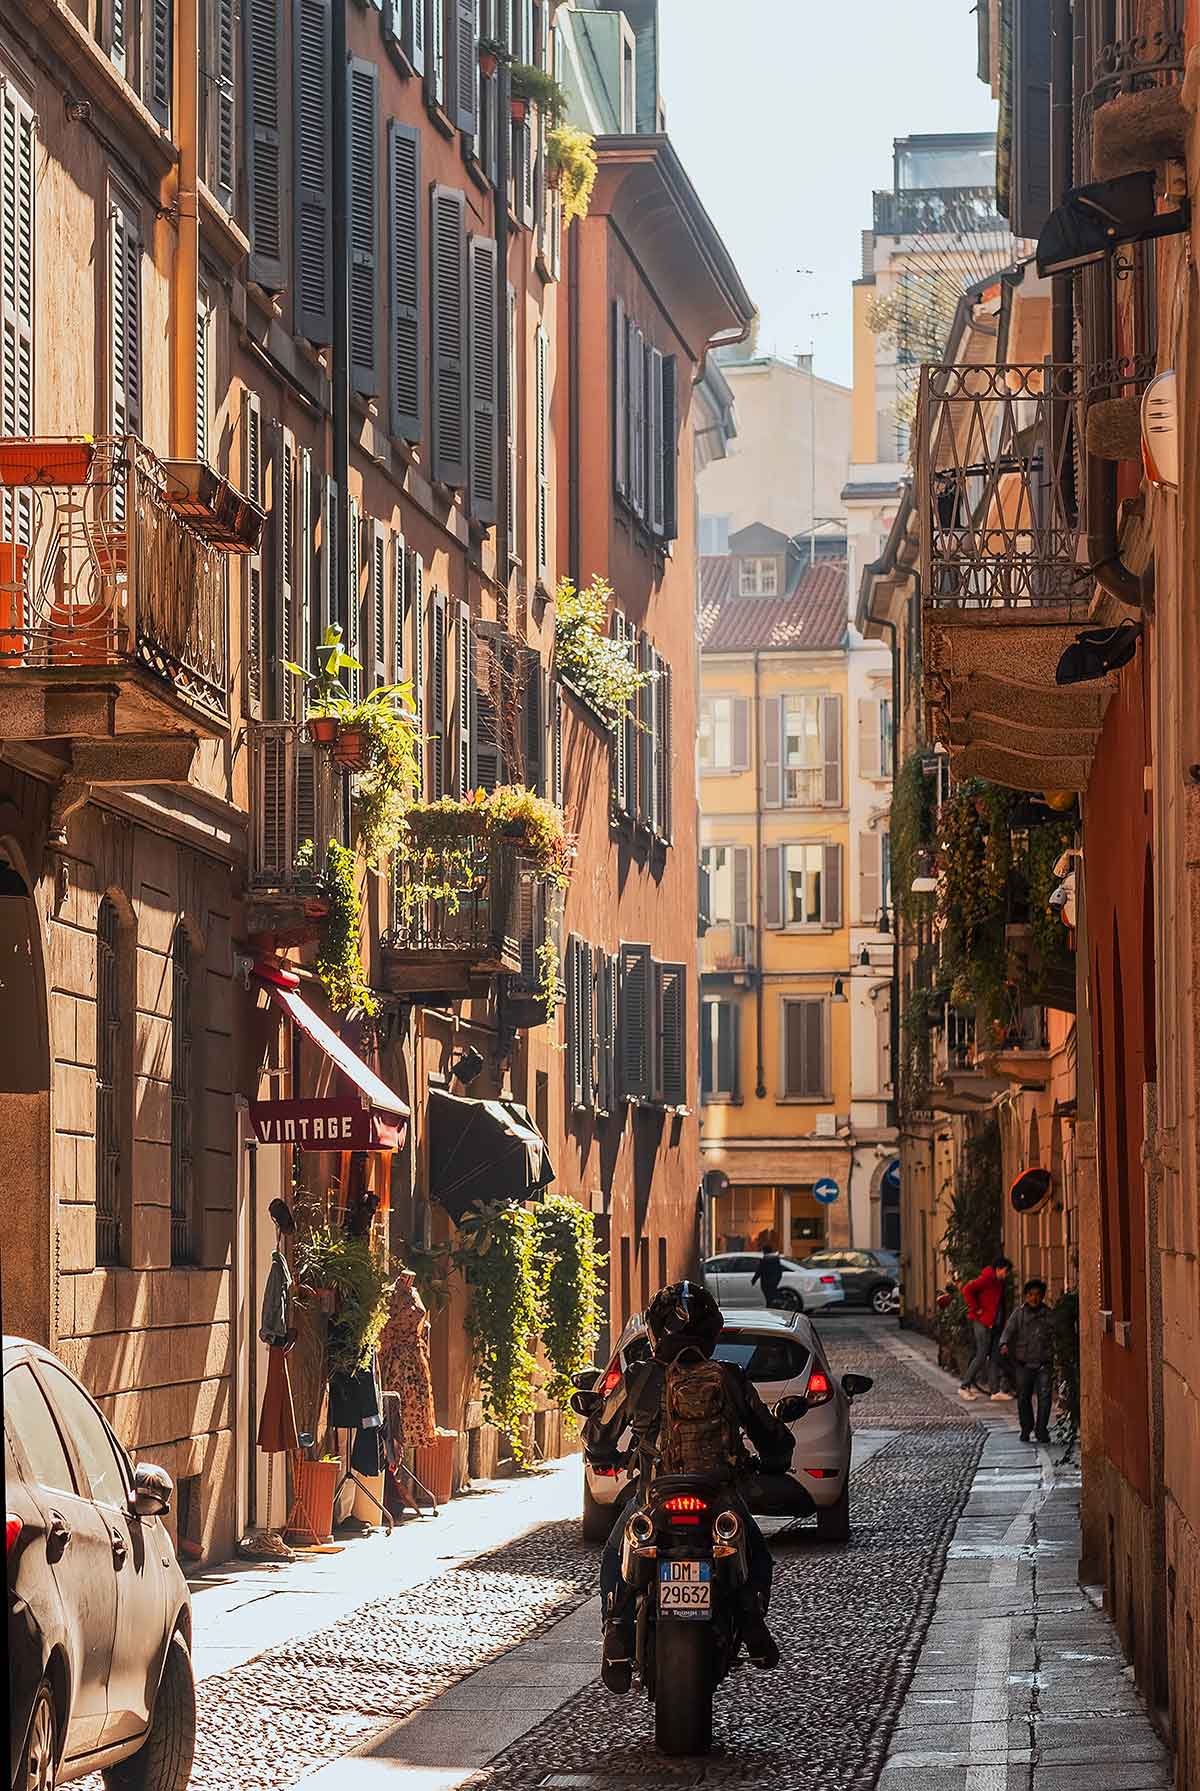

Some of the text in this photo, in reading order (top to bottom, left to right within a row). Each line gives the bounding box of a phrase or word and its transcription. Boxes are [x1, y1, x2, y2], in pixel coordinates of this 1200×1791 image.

[260, 1117, 352, 1141] VINTAGE
[672, 1563, 691, 1580] DM
[662, 1586, 709, 1604] 29632
